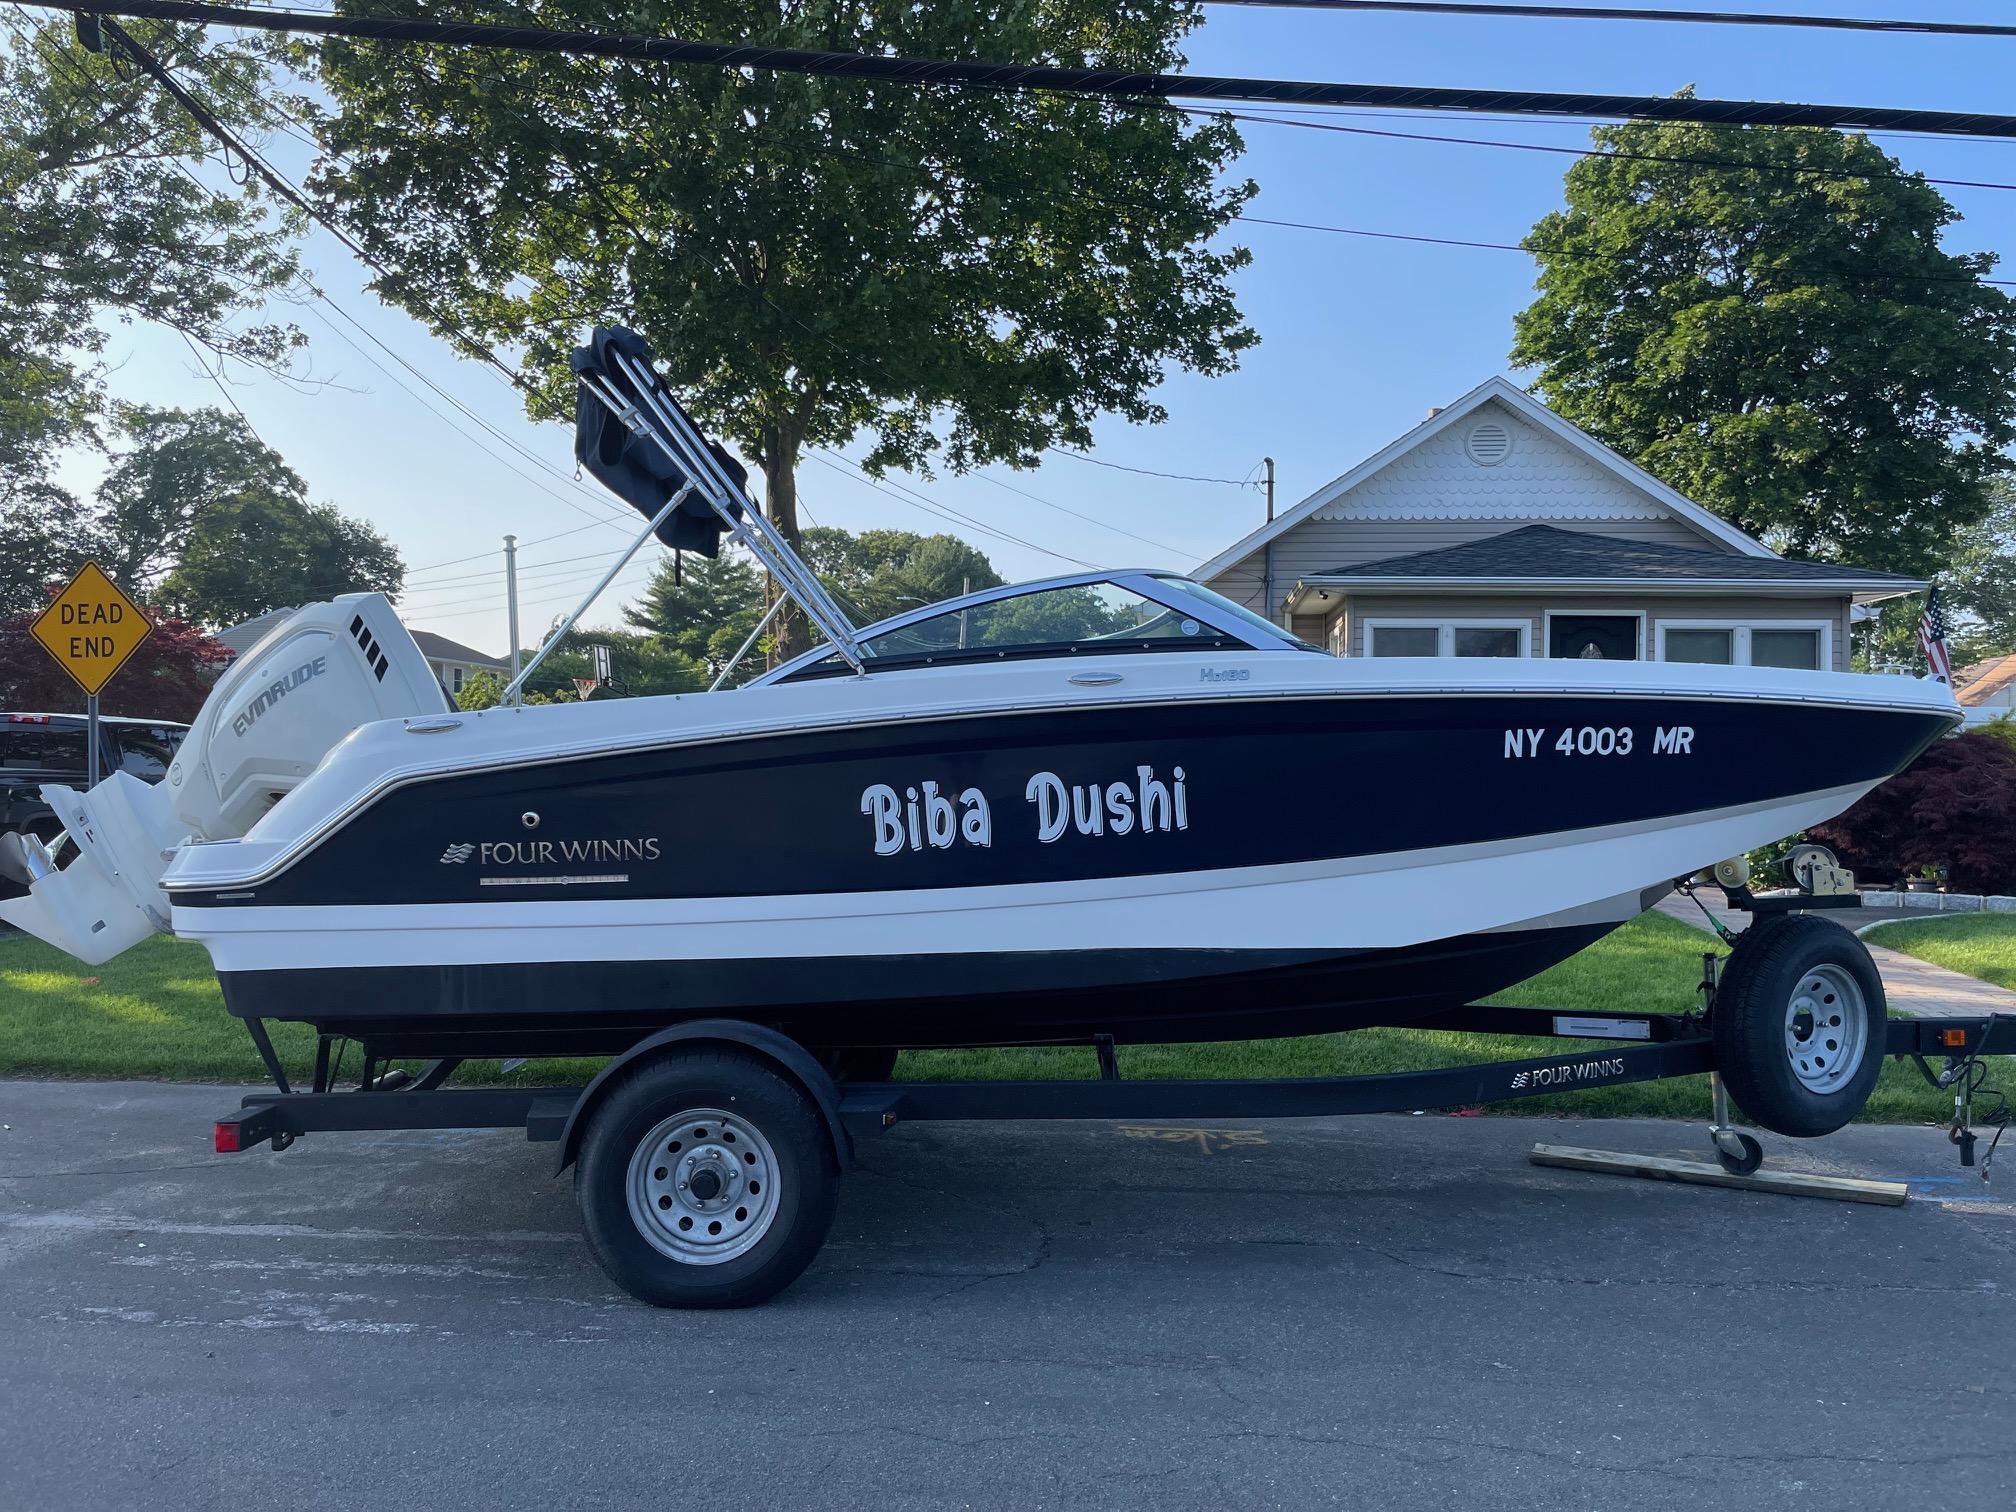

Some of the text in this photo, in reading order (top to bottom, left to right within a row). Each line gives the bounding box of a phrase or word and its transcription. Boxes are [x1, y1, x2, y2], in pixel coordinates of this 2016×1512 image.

[61, 603, 123, 625] DEAD
[70, 636, 115, 658] END
[232, 656, 326, 738] EVINRUDE
[1504, 726, 1695, 758] NY 4003 MR
[860, 765, 1188, 856] Biba Dushi
[480, 838, 661, 865] FOUR WINNS
[1532, 1058, 1625, 1087] FOUR WINNS
